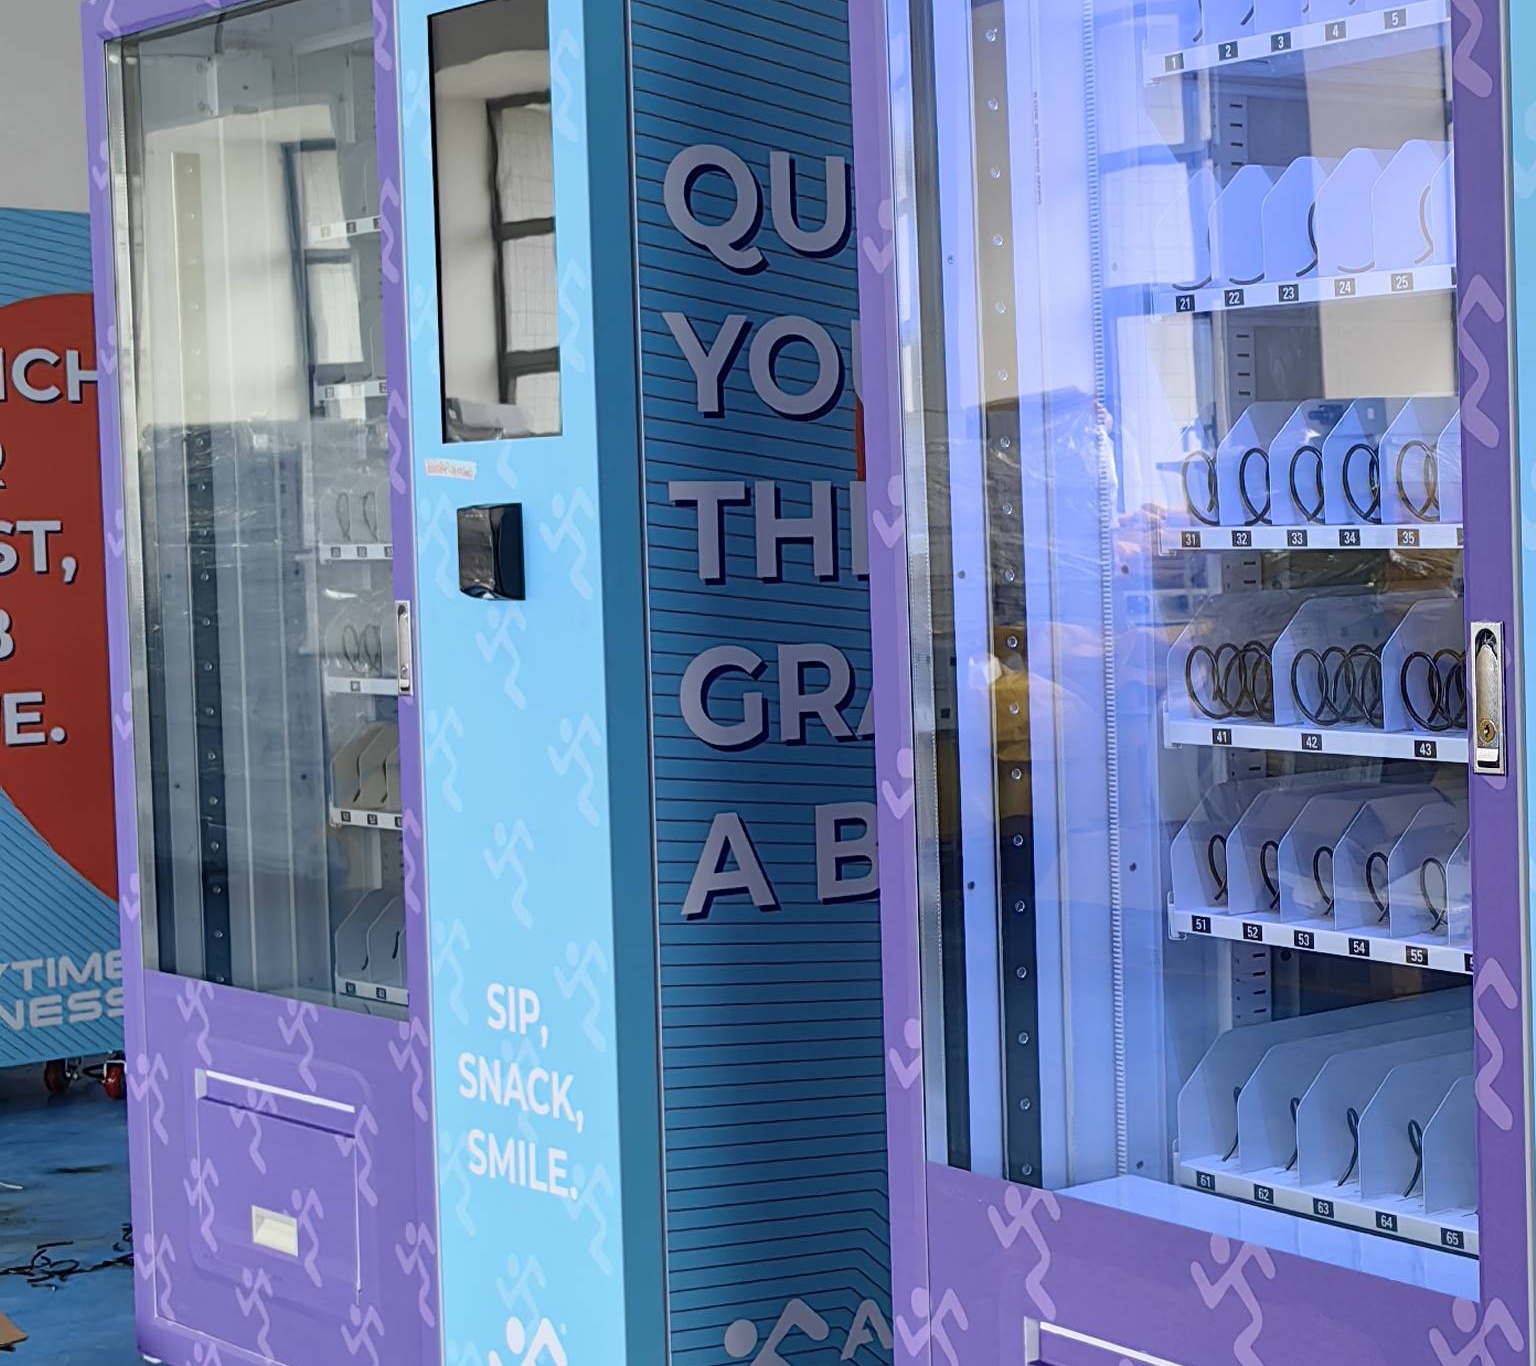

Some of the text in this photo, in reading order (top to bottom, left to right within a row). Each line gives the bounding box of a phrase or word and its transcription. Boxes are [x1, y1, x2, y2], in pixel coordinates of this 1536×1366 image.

[681, 812, 781, 921] A
[487, 983, 548, 1048] SIP,
[458, 1052, 583, 1132] SNACK,
[468, 1129, 578, 1200] SMILE.
